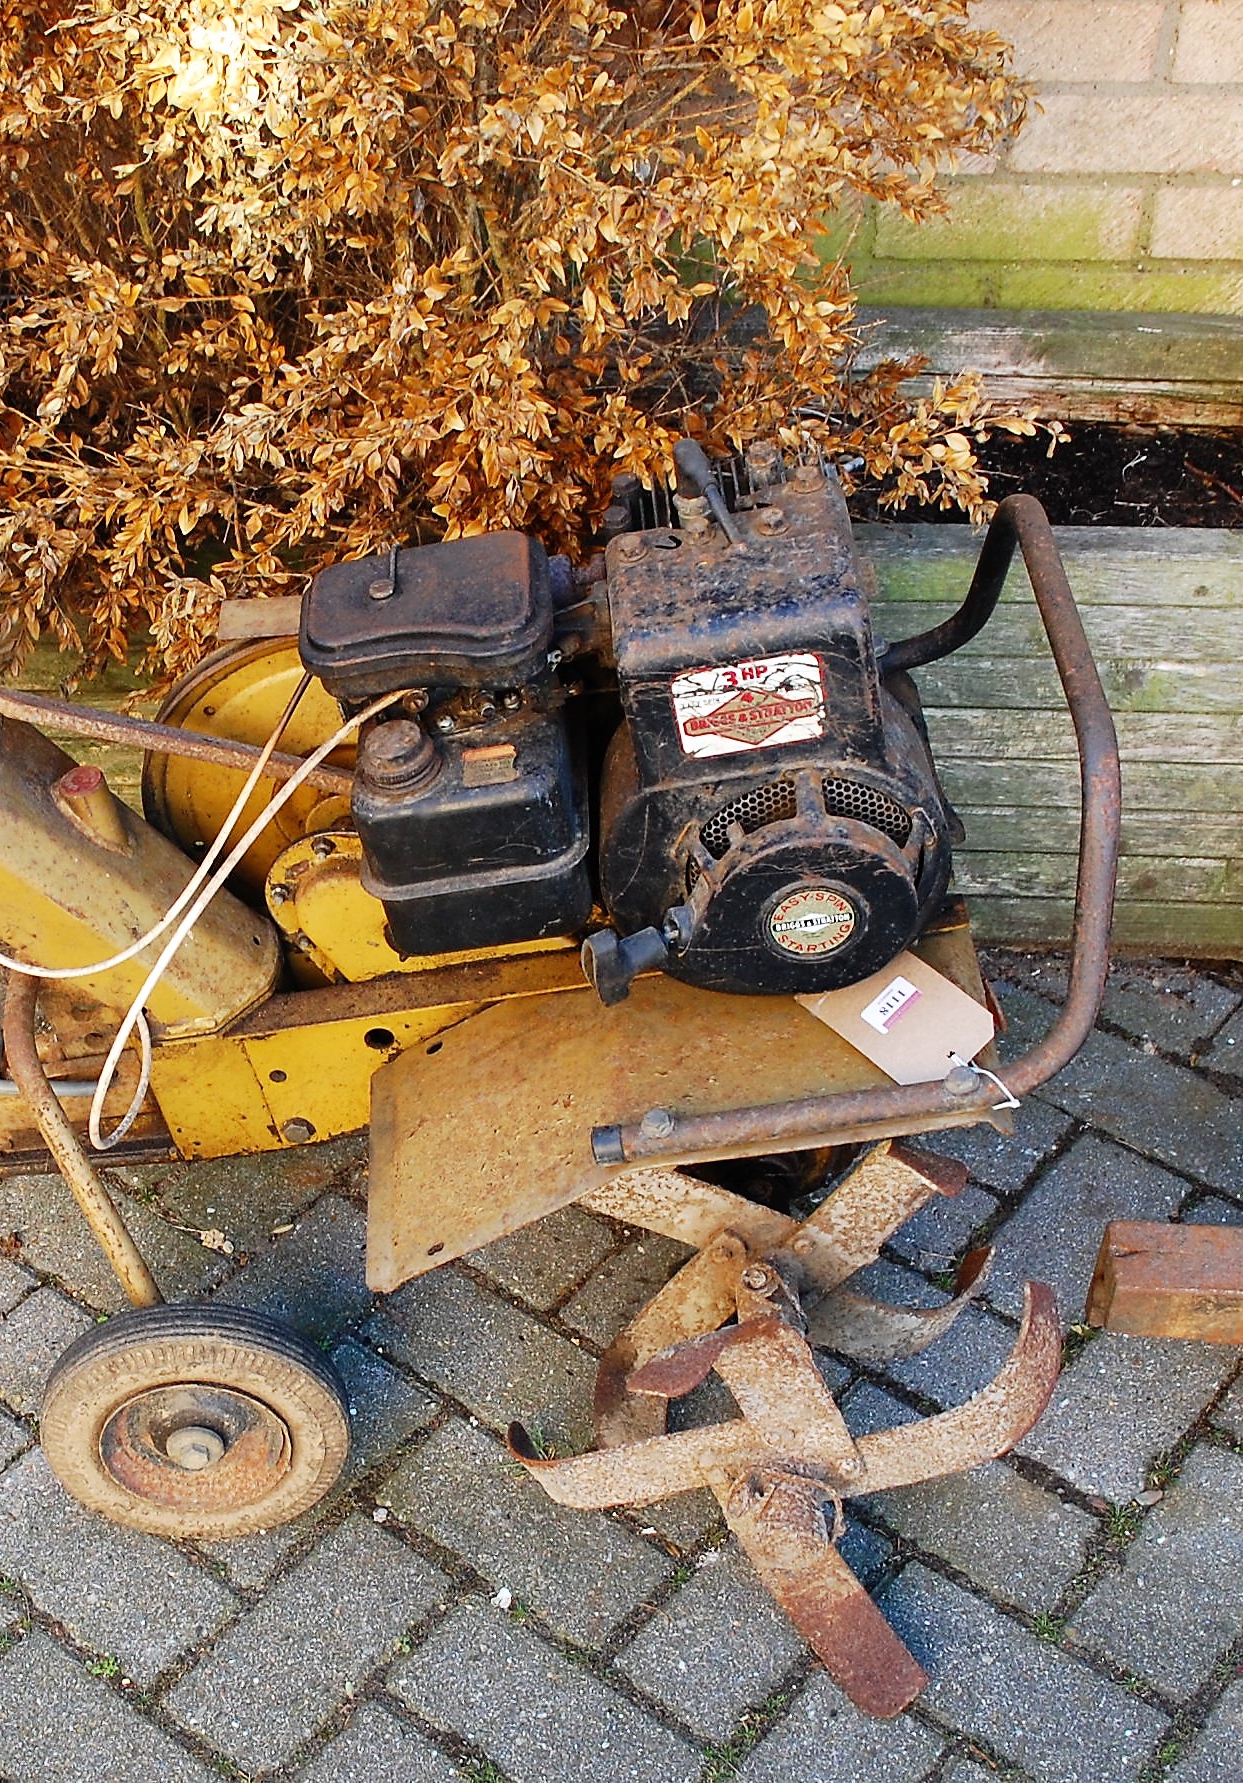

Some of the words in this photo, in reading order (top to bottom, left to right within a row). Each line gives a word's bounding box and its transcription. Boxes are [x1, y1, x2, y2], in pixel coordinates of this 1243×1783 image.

[722, 670, 739, 690] 3
[741, 665, 768, 681] HP
[690, 712, 736, 731] BRIGGS
[775, 918, 806, 932] BRIGGS
[777, 923, 851, 953] STARTING
